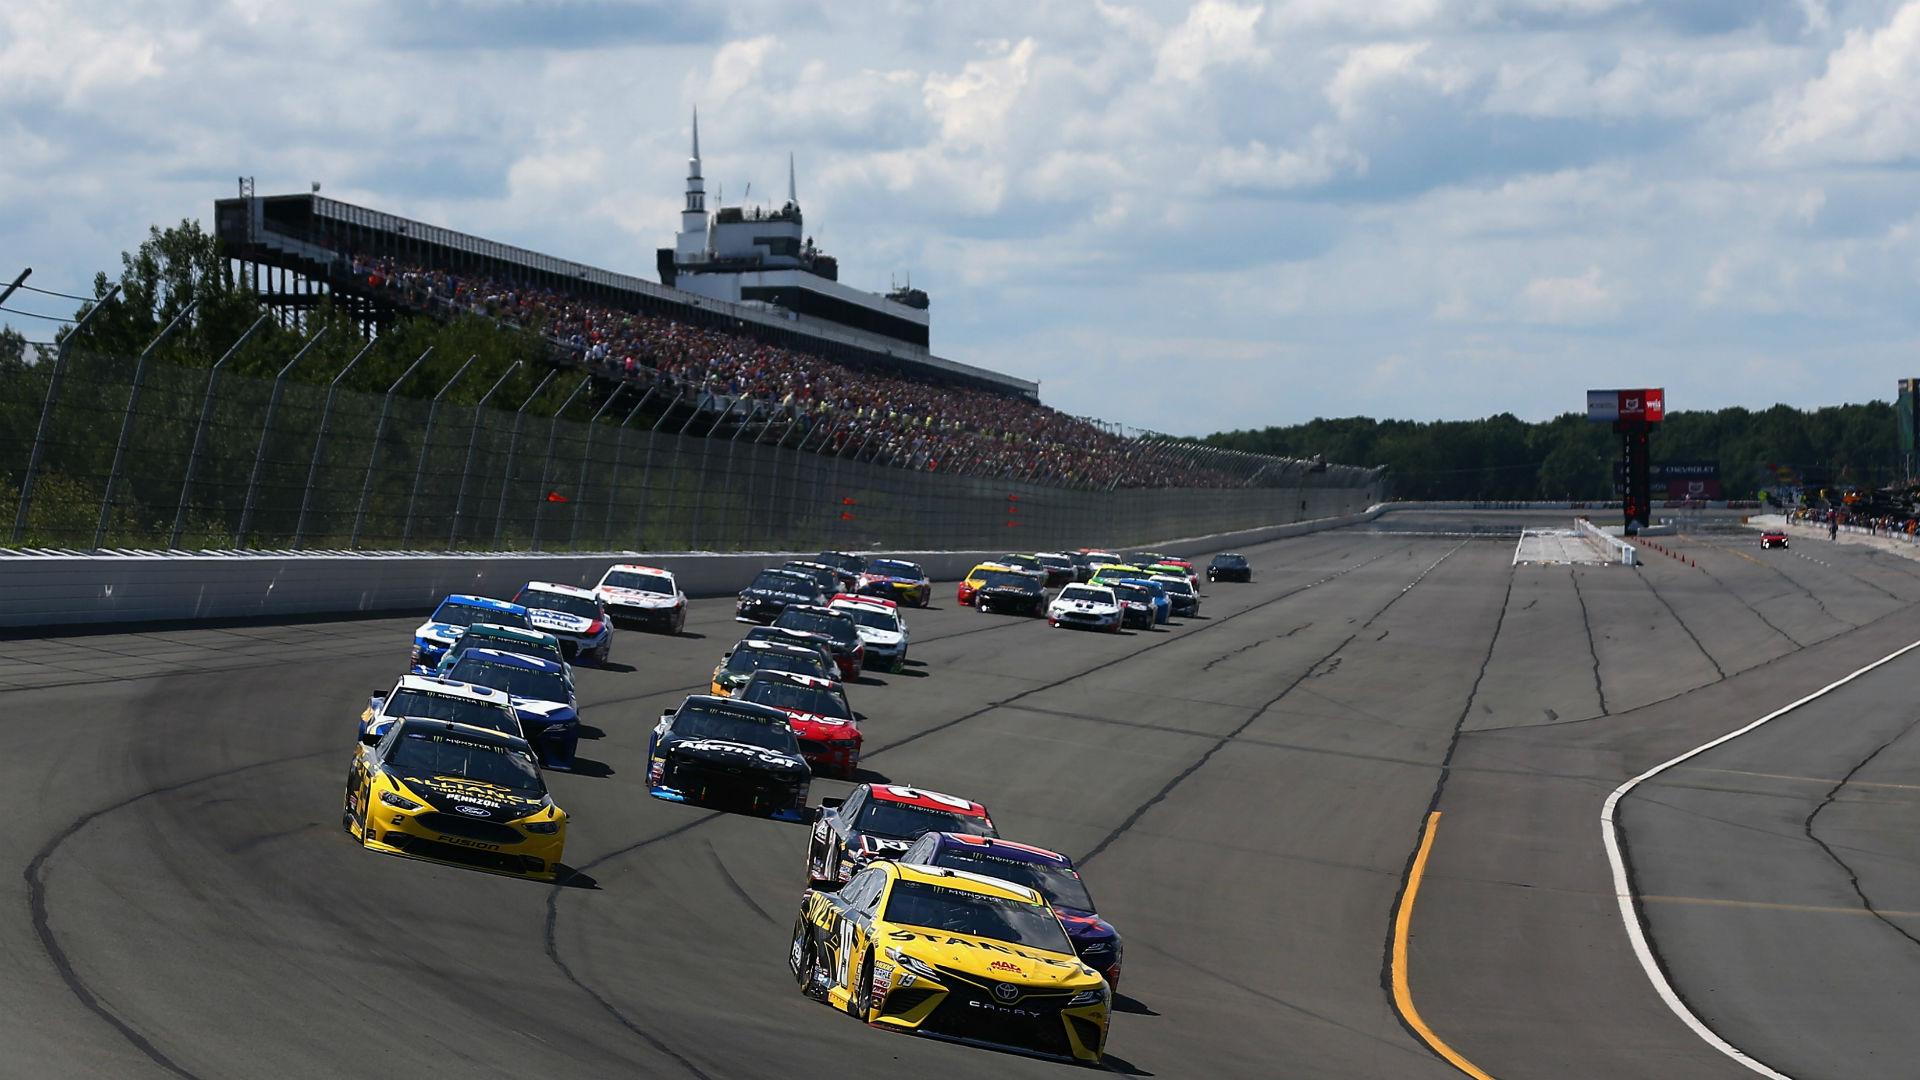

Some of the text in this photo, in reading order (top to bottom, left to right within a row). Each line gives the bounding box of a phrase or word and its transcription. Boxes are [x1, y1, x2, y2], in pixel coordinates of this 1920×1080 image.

[445, 738, 491, 750] MONSTER
[678, 742, 756, 757] ARCTIC
[759, 754, 801, 768] CAT
[403, 776, 543, 808] ALLIANCE
[432, 786, 517, 806] TRUCK PARTS
[446, 793, 501, 808] PENNZOIL
[391, 815, 405, 826] 2
[438, 834, 500, 851] FUSION
[888, 929, 1097, 977] STANLEY
[897, 972, 917, 987] 19
